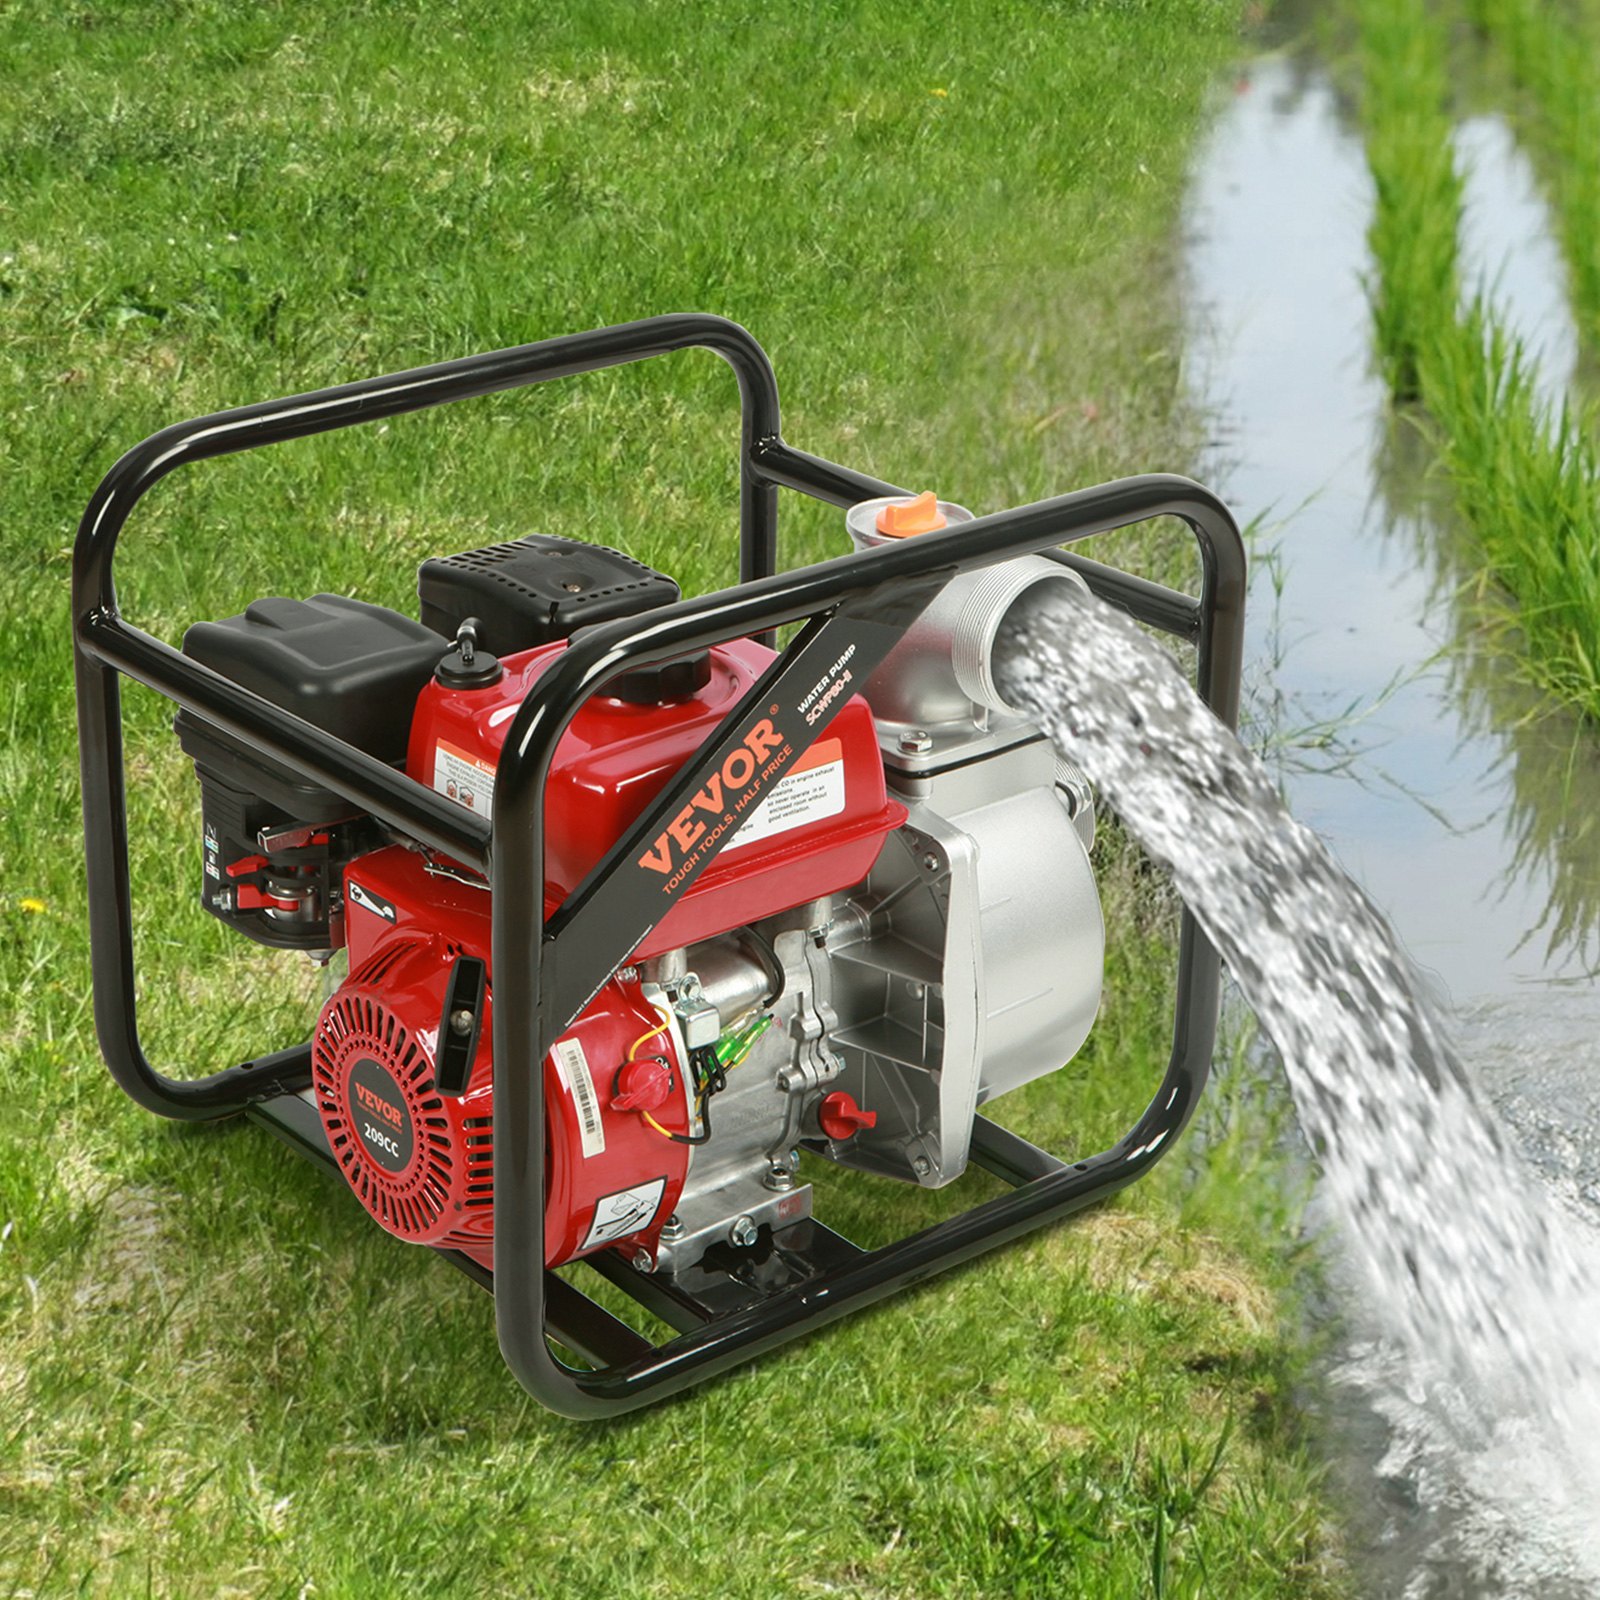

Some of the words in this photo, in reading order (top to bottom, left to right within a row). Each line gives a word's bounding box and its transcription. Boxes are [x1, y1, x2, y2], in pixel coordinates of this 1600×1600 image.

[797, 675, 831, 714] WATER
[828, 644, 856, 678] PUMP
[638, 718, 785, 875] VEVOR
[796, 773, 814, 782] engine
[662, 852, 700, 895] TOUGH
[698, 813, 738, 853] TOOLS,
[734, 779, 762, 813] HALF
[761, 744, 794, 782] PRICE
[354, 1081, 403, 1127] VEVOR
[364, 1122, 400, 1158] 209CC
